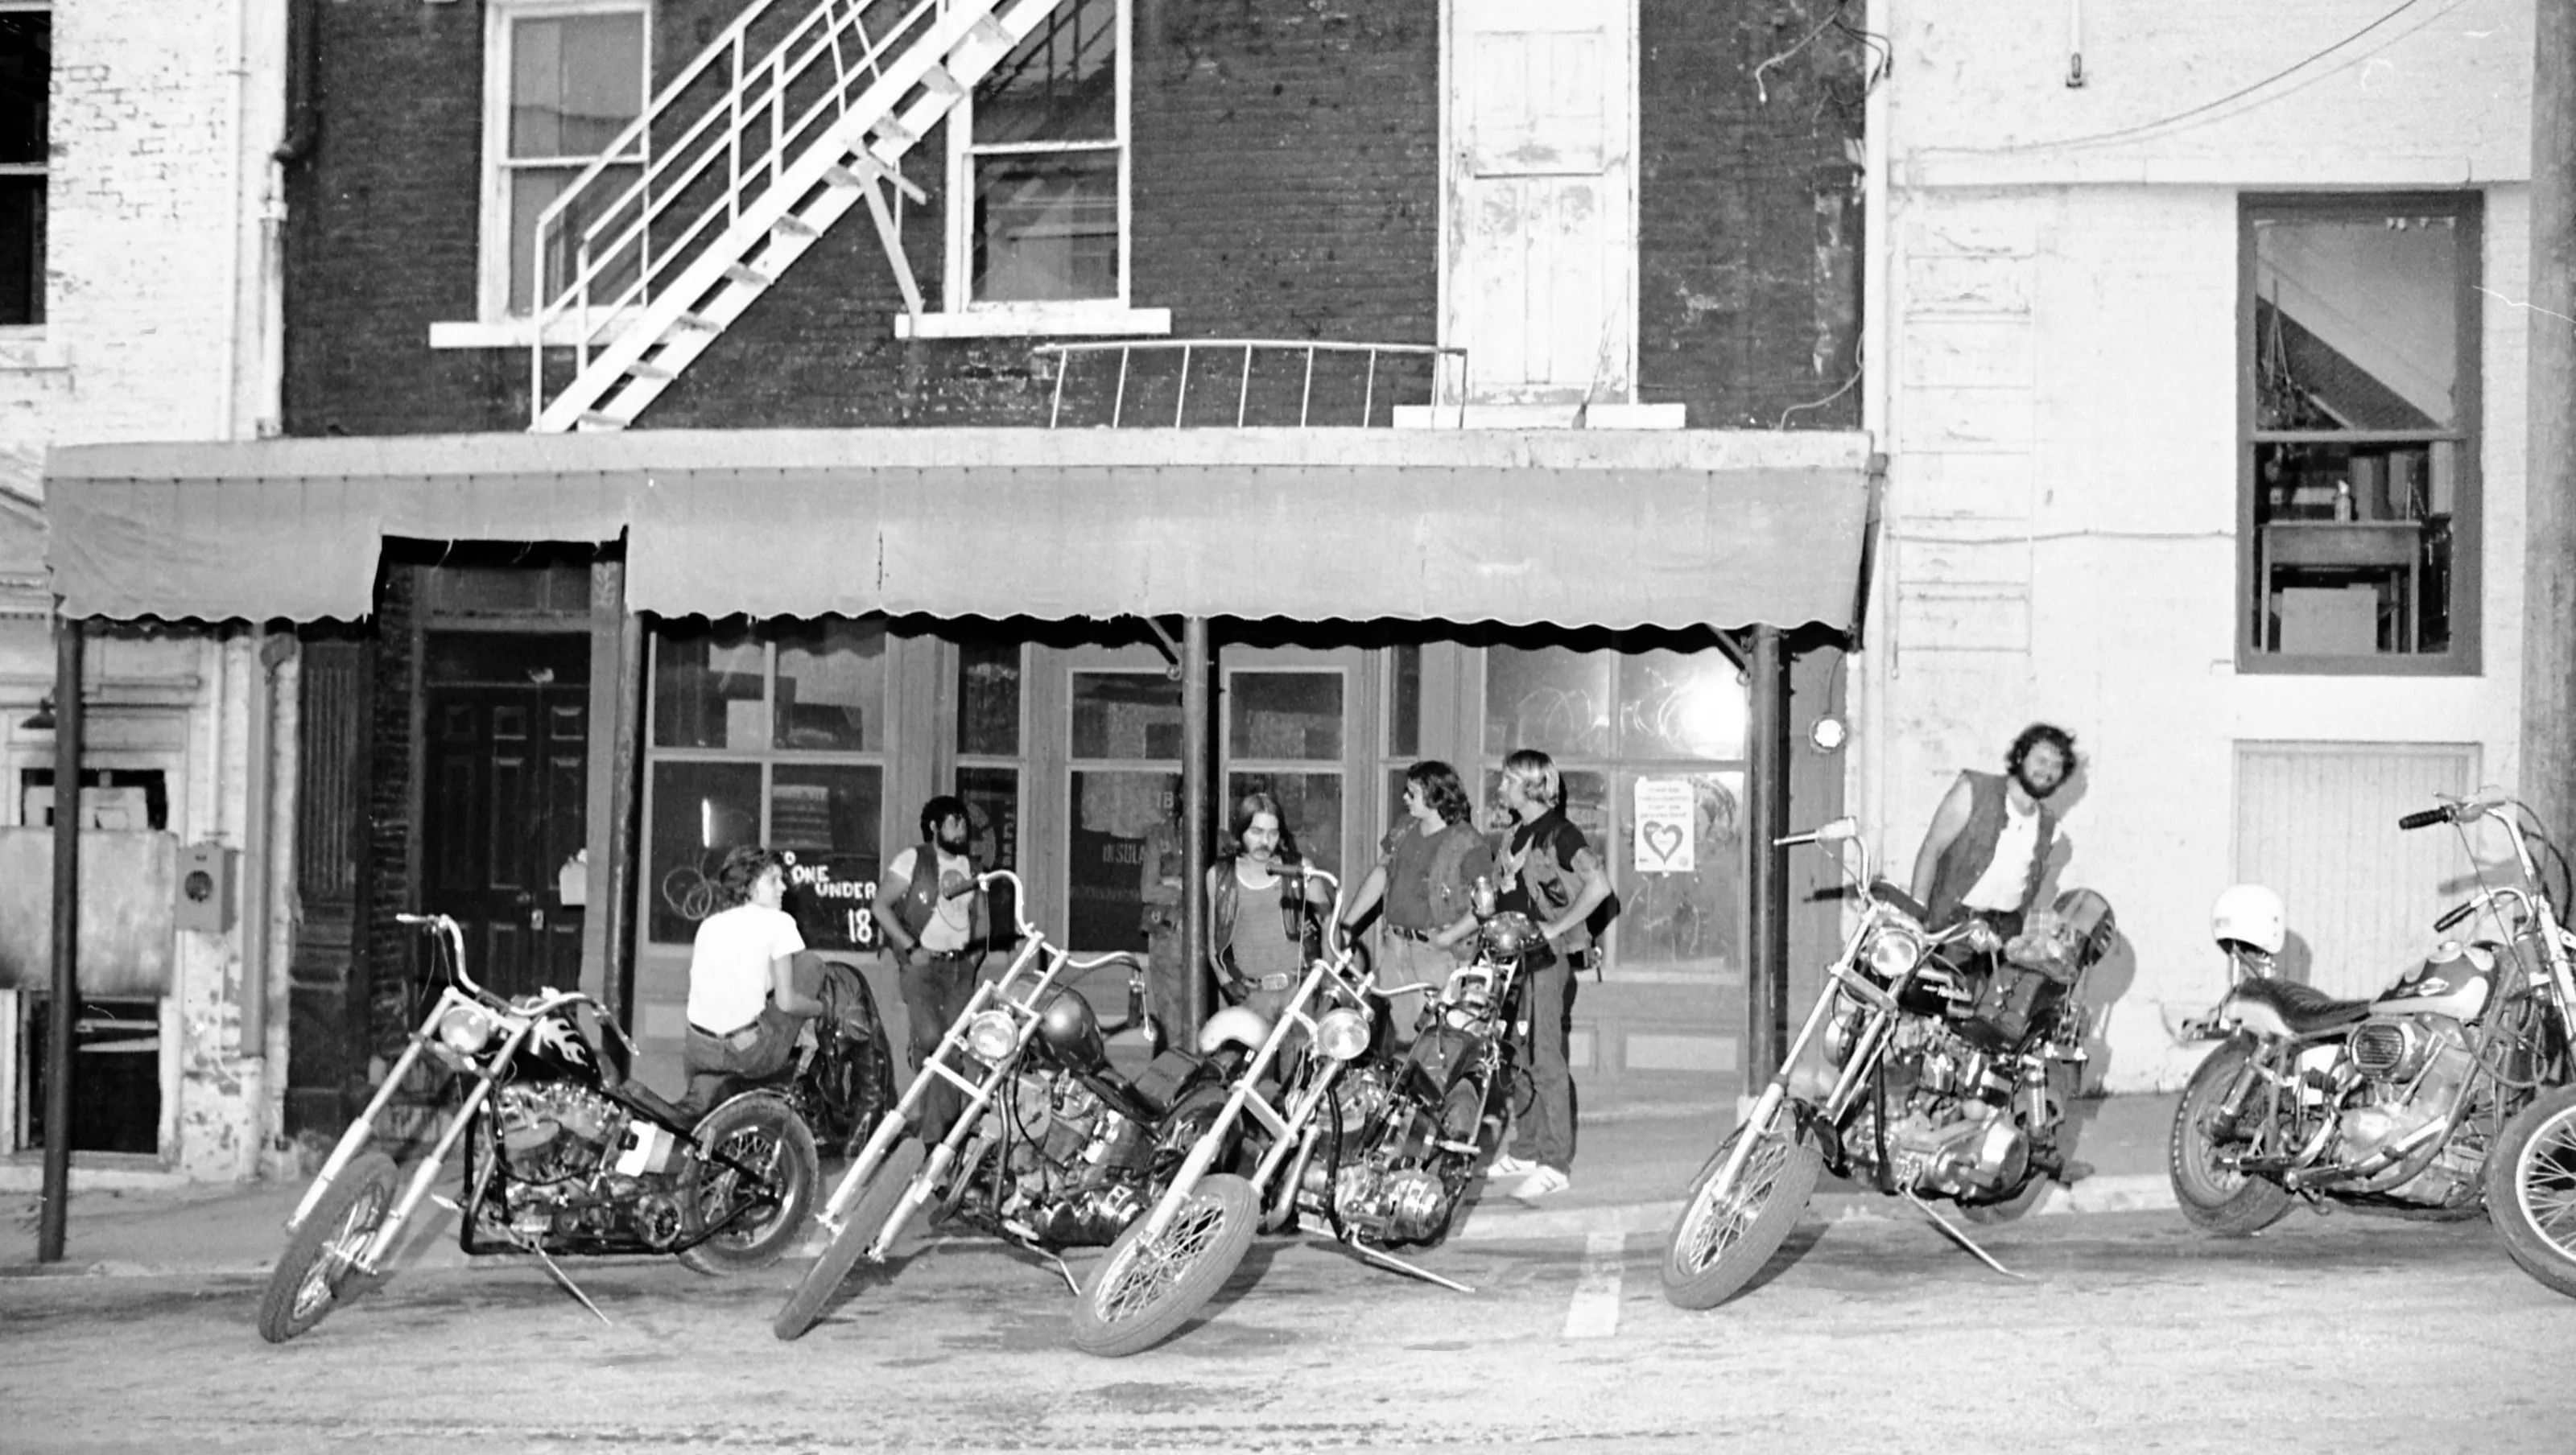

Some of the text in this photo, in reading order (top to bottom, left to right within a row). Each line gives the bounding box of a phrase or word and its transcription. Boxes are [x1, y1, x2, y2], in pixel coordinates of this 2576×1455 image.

[791, 864, 830, 884] ONE
[814, 881, 877, 900] UNDER
[848, 908, 872, 943] 18
